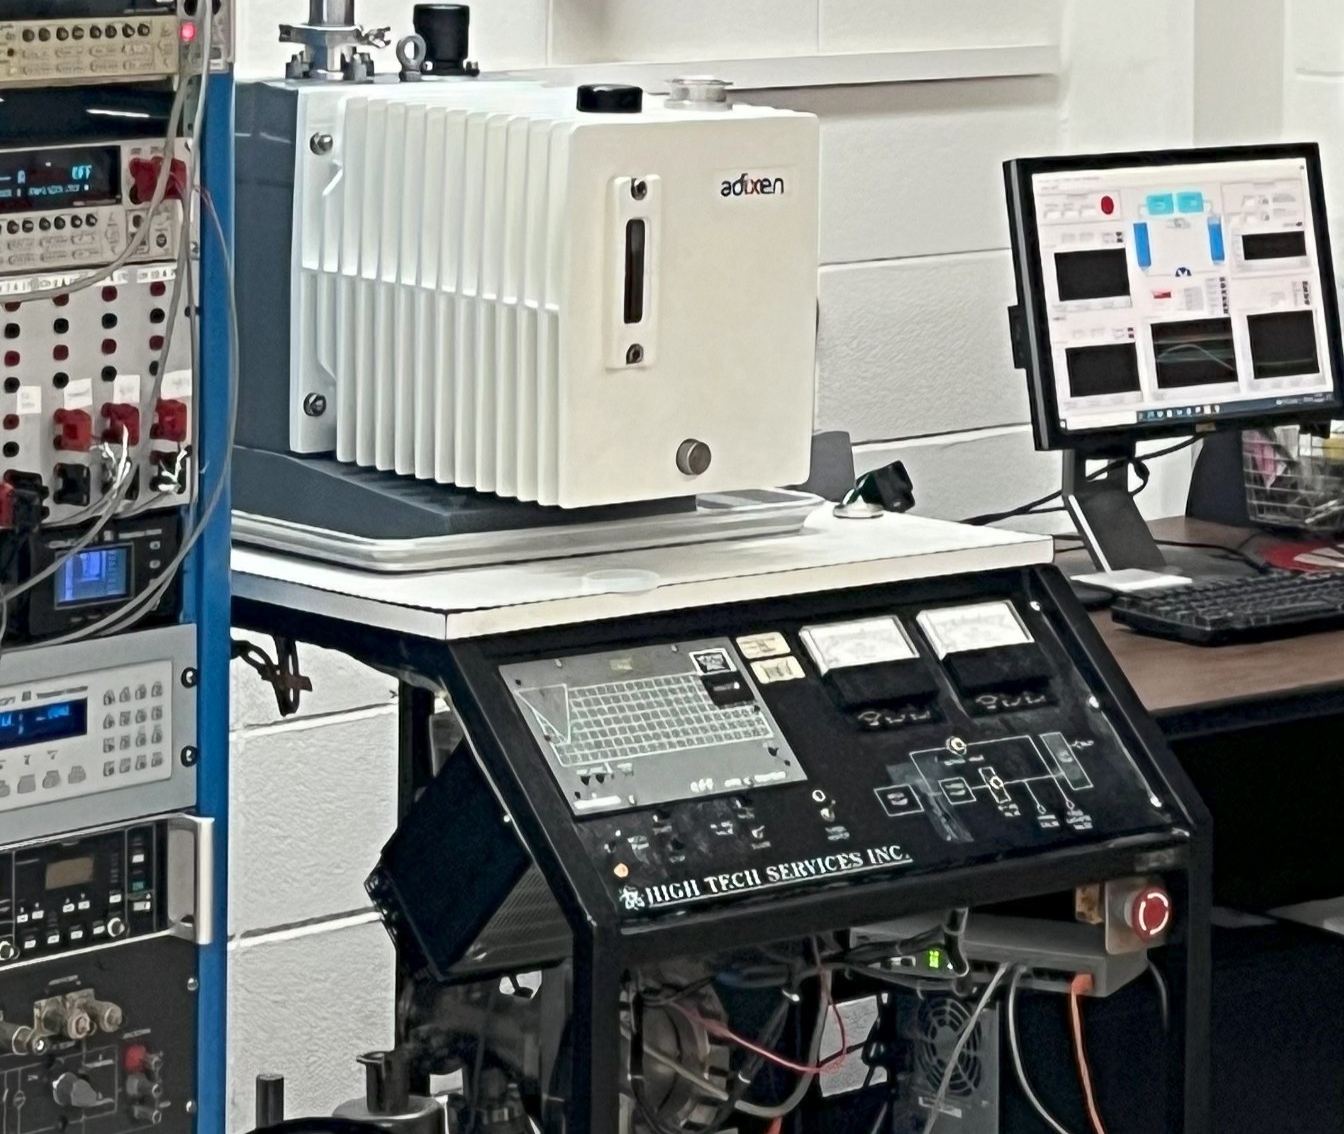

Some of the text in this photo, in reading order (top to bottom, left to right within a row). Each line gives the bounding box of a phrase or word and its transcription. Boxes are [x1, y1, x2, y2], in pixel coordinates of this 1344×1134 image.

[720, 172, 785, 197] adixen
[644, 844, 910, 906] HIGH TECH SERVICES INC.
